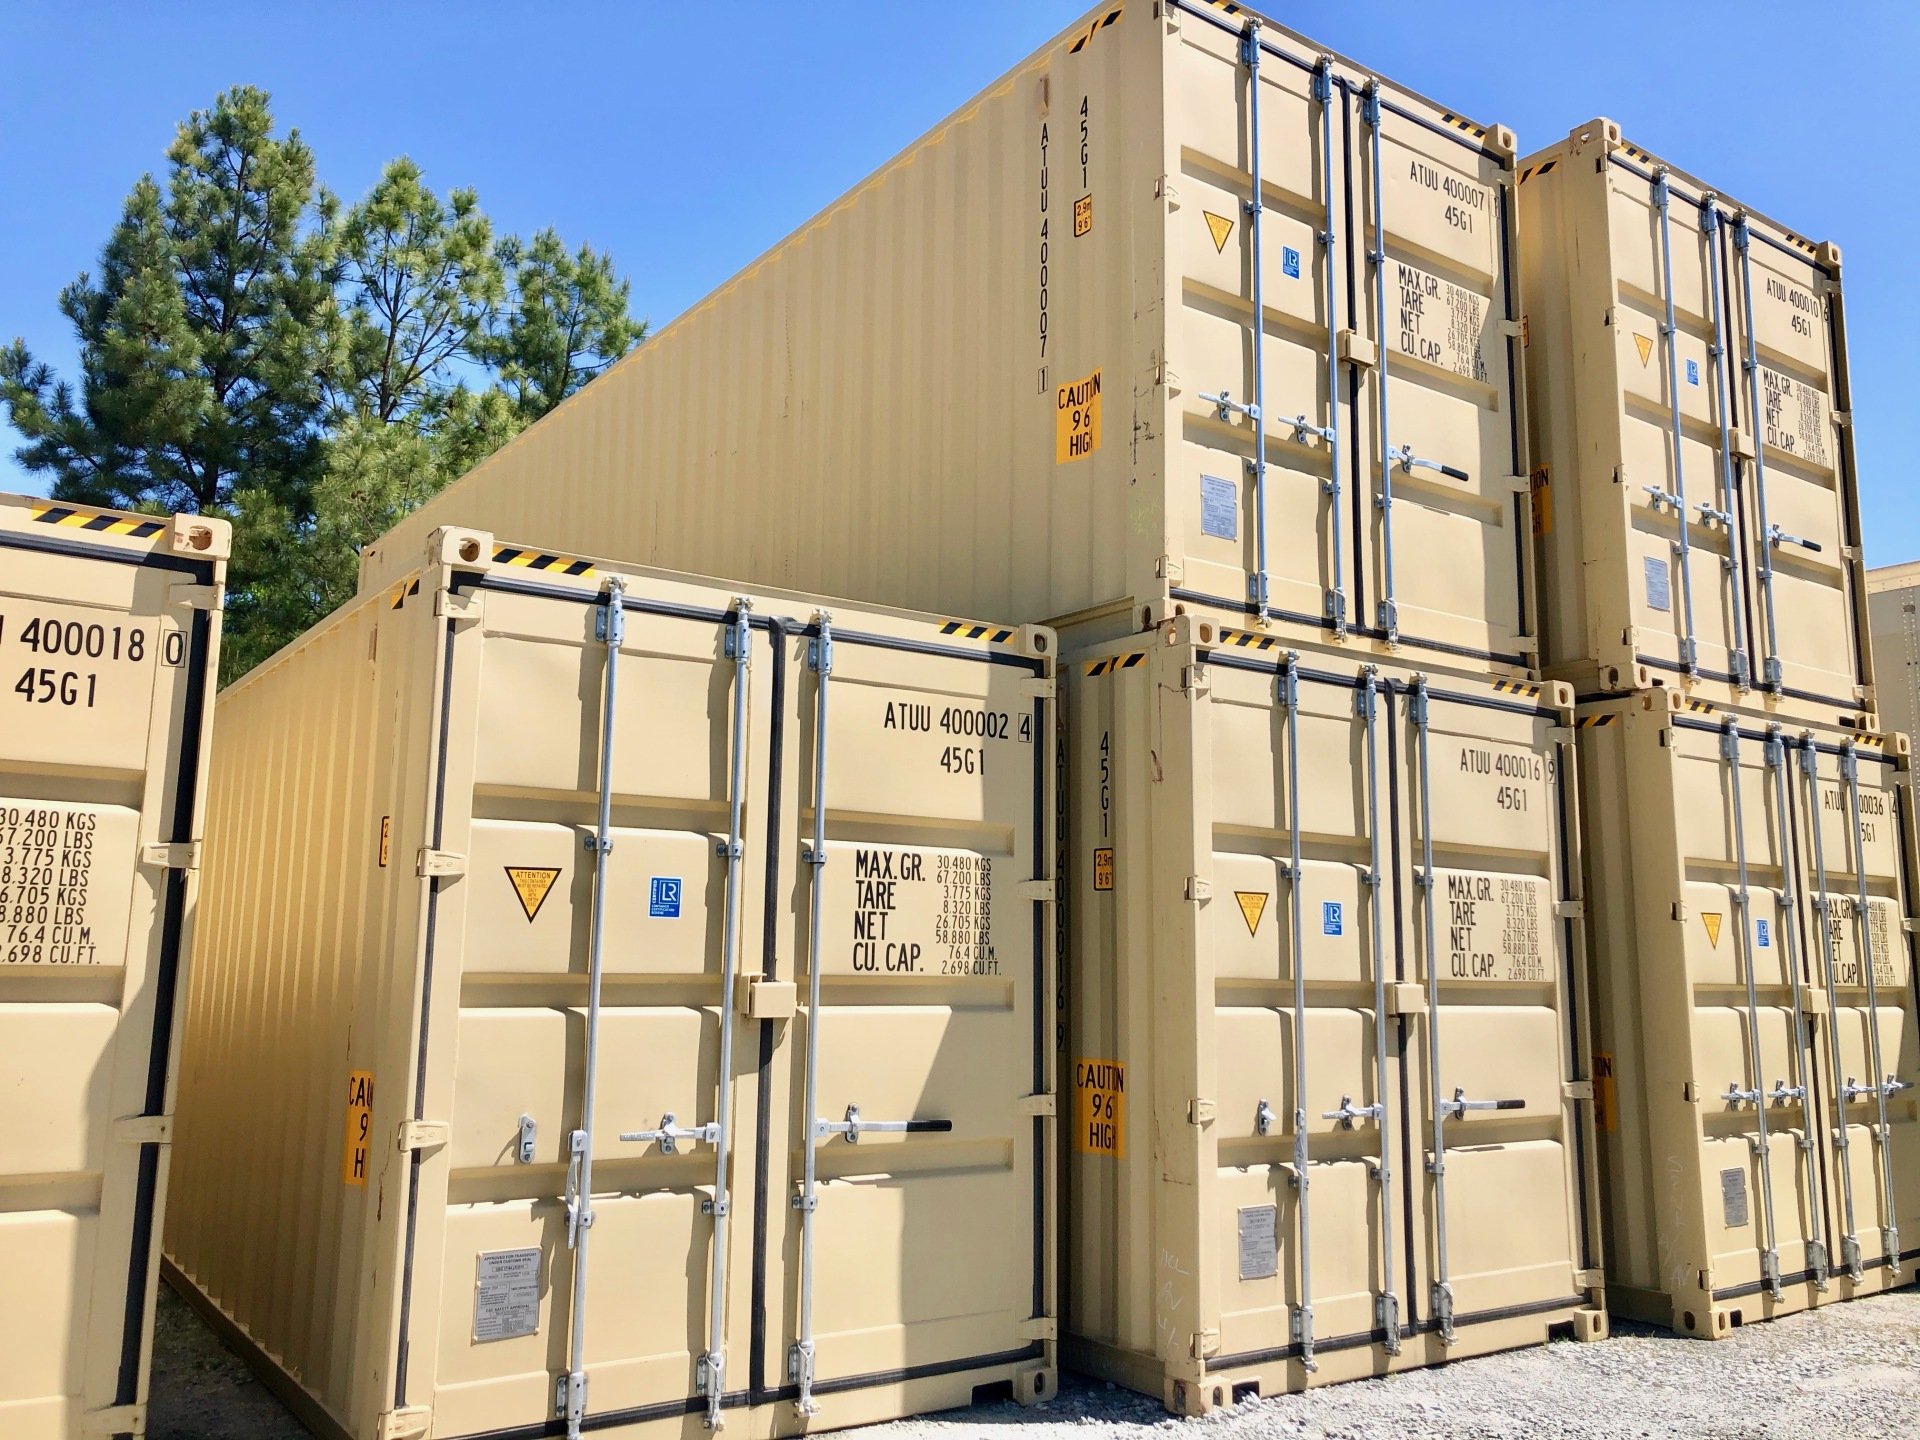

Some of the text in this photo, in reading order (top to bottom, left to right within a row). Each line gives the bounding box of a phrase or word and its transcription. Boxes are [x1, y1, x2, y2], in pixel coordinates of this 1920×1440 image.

[1080, 96, 1088, 188] 45G1
[1040, 122, 1048, 213] ATUU
[1410, 161, 1438, 191] ATUU
[1443, 176, 1485, 211] 400007
[1444, 205, 1473, 234] 45G1
[1040, 218, 1048, 358] 400007
[1400, 286, 1425, 315] TARE
[1766, 277, 1786, 303] ATUU
[1789, 288, 1819, 319] 400010
[1400, 312, 1420, 335] NET
[1792, 314, 1811, 339] 45G1
[1765, 387, 1782, 412] TARE
[1766, 406, 1780, 429] NET
[20, 617, 144, 662] 400018
[165, 632, 183, 665] 0
[15, 667, 96, 707] 45G1
[884, 702, 930, 732] ATUU
[940, 707, 1009, 739] 400002
[940, 746, 984, 775] 45G1
[1460, 748, 1490, 775] ATUU
[1496, 753, 1541, 781] 400016
[1100, 731, 1109, 837] 45G1
[1497, 786, 1527, 811] 45G1
[1859, 794, 1884, 815] 00036
[66, 812, 96, 831] KGS
[1861, 822, 1875, 842] 5G1
[63, 830, 93, 849] LBS
[61, 849, 91, 868] KGS
[975, 857, 992, 872] KGS
[59, 868, 88, 887] LBS
[975, 871, 991, 886] LBS
[56, 888, 87, 906] KGS
[662, 883, 677, 902] LR
[856, 880, 896, 910] TARE
[975, 886, 991, 900] KGS
[54, 907, 84, 925] LBS
[975, 901, 991, 915] LBS
[1449, 901, 1477, 926] TARE
[1828, 898, 1853, 919] AX.GR.
[8, 925, 45, 943] 76.4
[854, 911, 888, 940] NET
[974, 916, 991, 930] KGS
[974, 931, 990, 945] LBS
[1829, 920, 1843, 940] ARE
[1450, 927, 1472, 952] NET
[1832, 941, 1841, 961] ET
[886, 943, 924, 972] CAP.
[1472, 953, 1497, 979] CAP.
